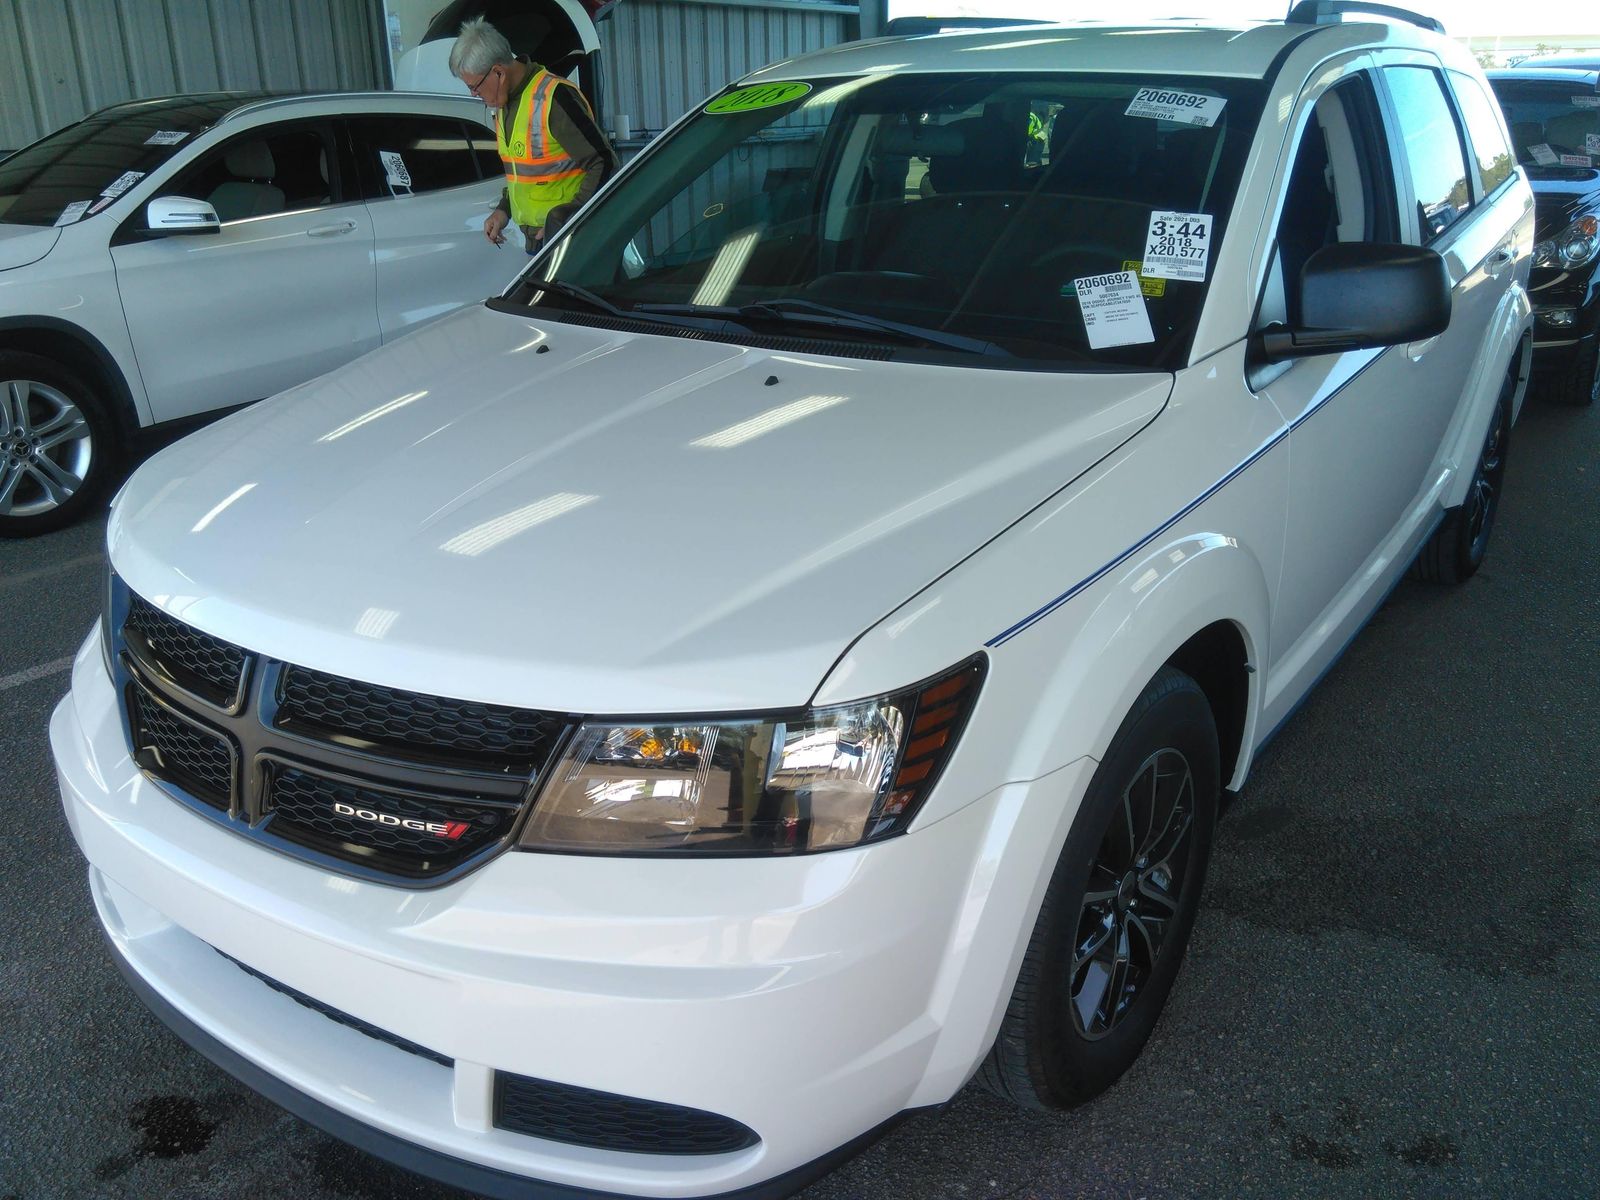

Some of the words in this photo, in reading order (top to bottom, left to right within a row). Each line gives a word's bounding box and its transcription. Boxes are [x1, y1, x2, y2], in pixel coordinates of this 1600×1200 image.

[714, 85, 798, 110] 2018
[1136, 89, 1208, 109] 2060692
[391, 155, 410, 185] 2060687
[1159, 236, 1192, 247] 2018
[1148, 244, 1206, 259] X20,577
[1076, 272, 1131, 290] 2060692
[1079, 288, 1093, 297] DLR
[334, 802, 449, 835] DODGE
